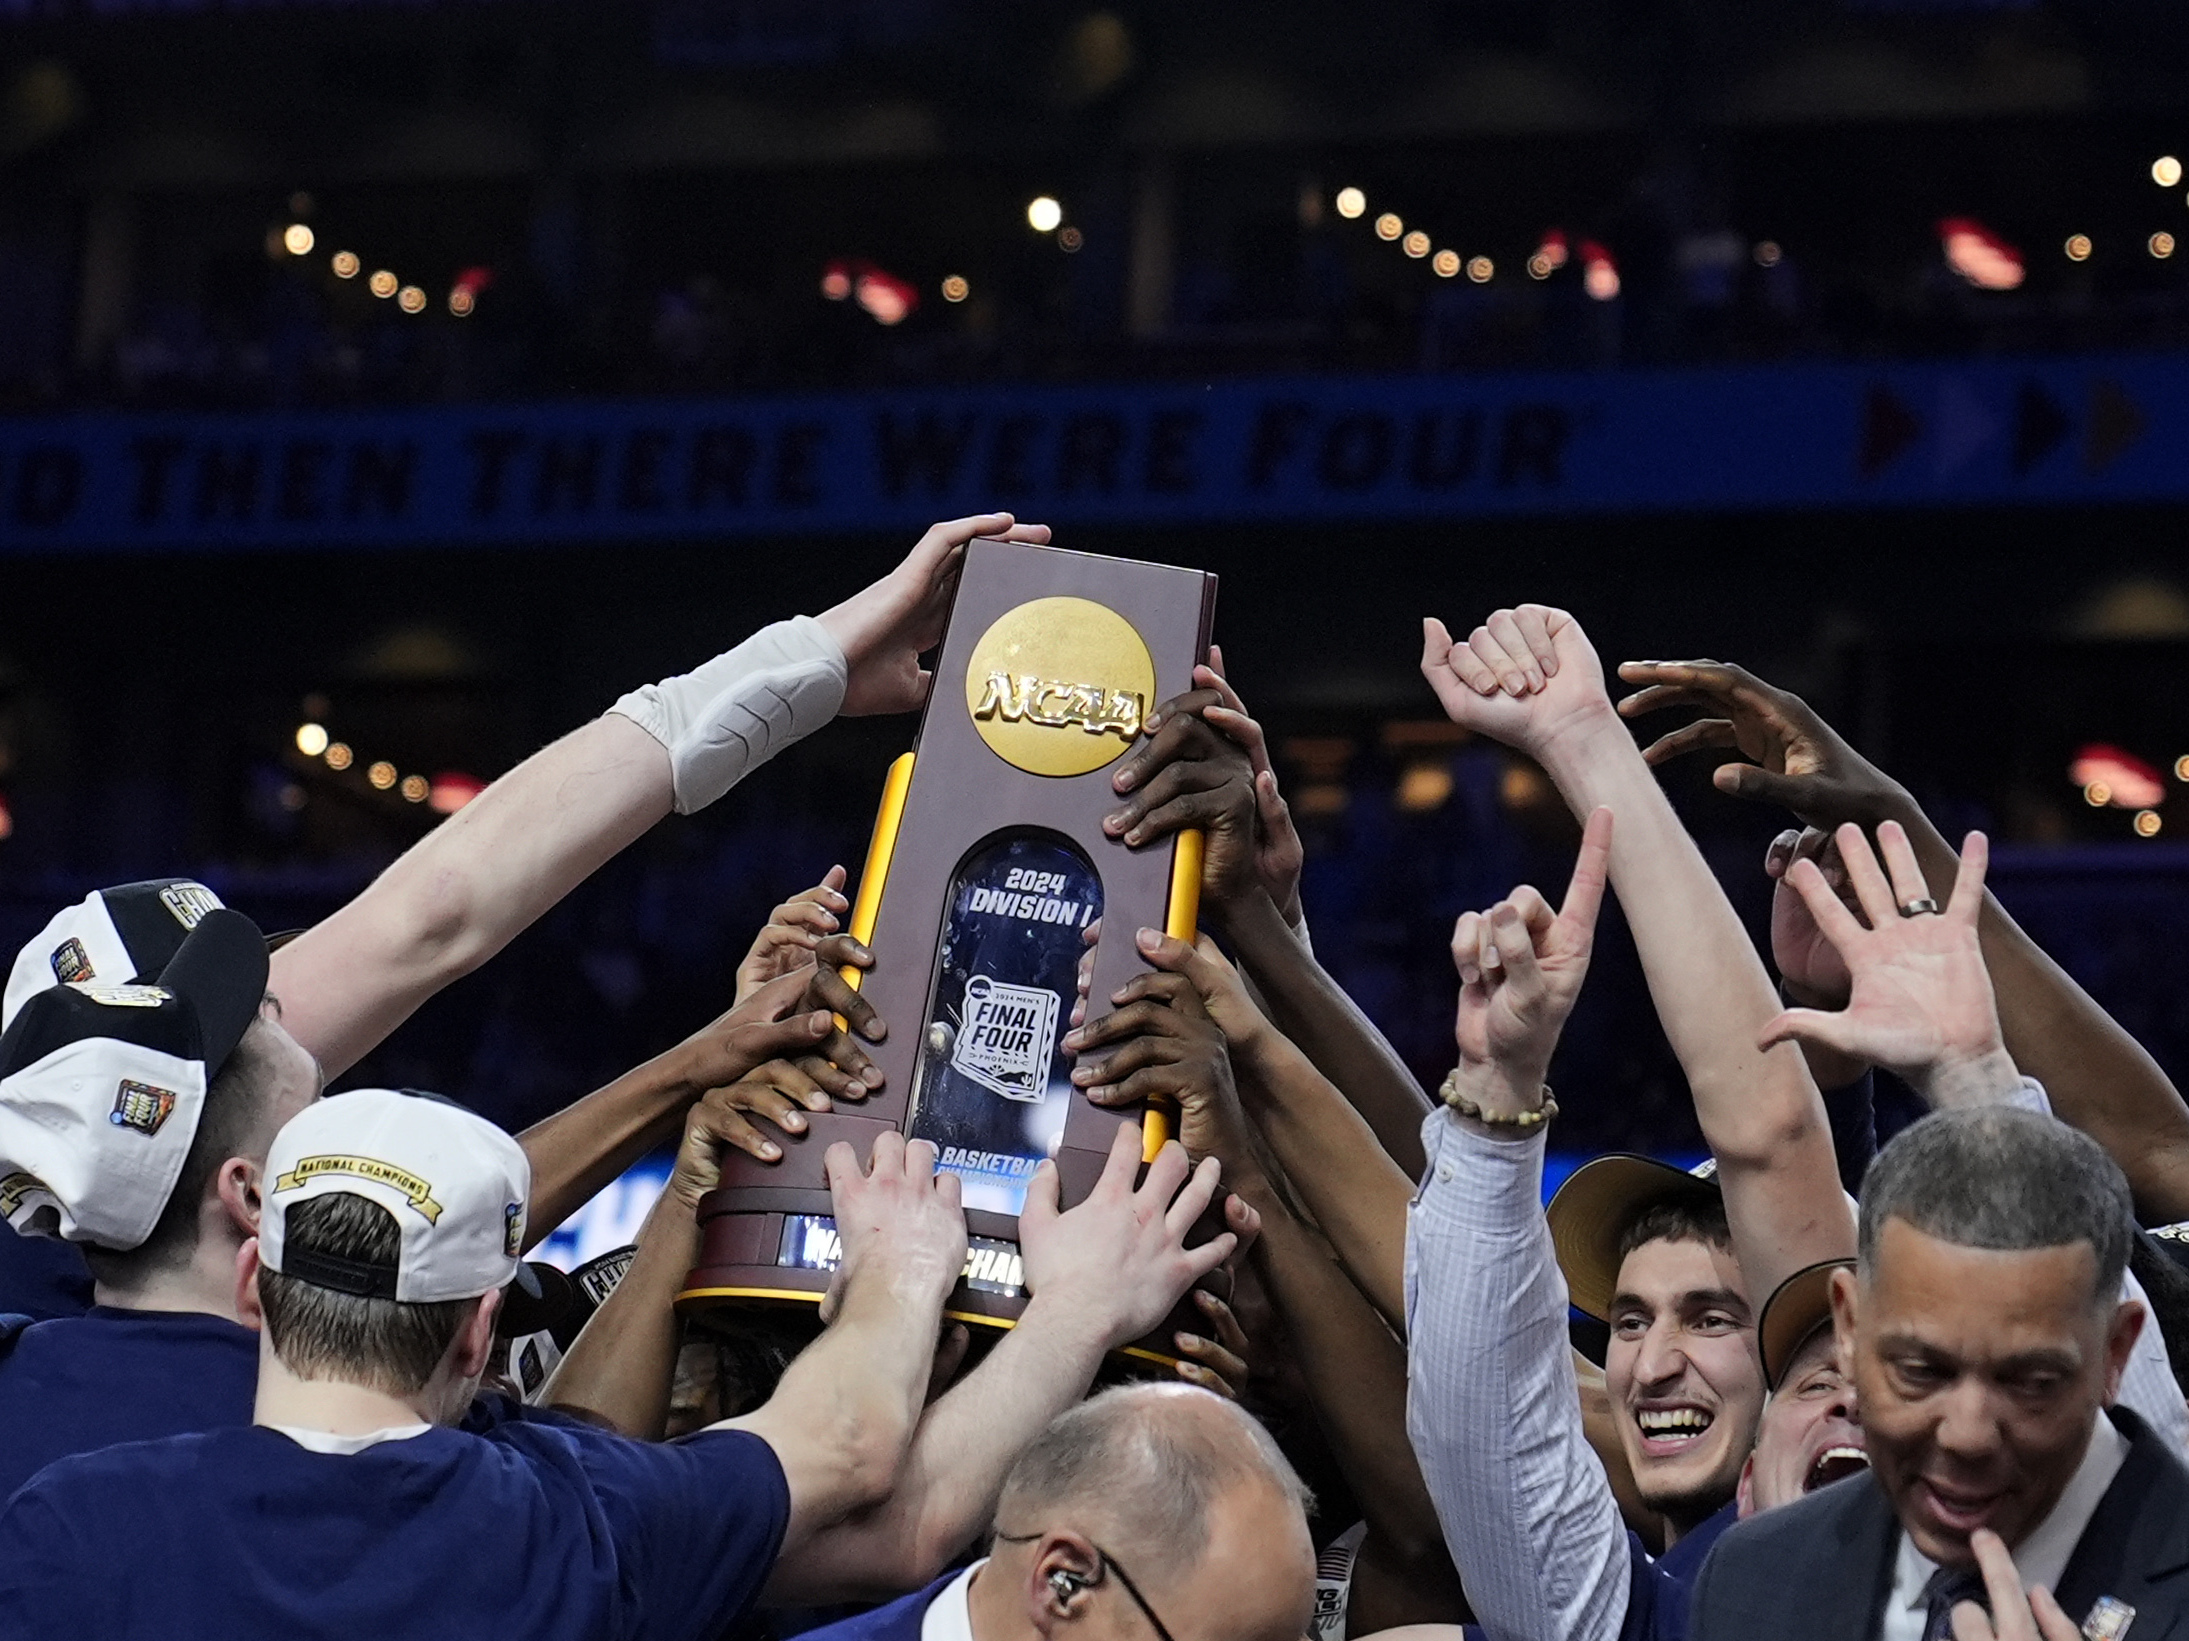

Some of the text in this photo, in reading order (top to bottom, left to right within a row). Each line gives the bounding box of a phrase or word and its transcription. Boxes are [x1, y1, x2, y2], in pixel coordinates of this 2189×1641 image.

[128, 433, 421, 527] THEN
[462, 422, 832, 520] THERE
[867, 409, 1197, 504] WERE
[1240, 399, 1580, 495] FOUR
[974, 670, 1145, 743] NCAA
[1005, 867, 1066, 896] 2024
[969, 888, 1094, 928] DIVISION I
[975, 1001, 1037, 1031] FINAL
[971, 1025, 1034, 1053] FOUR
[978, 1054, 1018, 1065] PHOENIX
[133, 1093, 152, 1127] FOUR
[300, 1159, 424, 1195] NATIONAL CHAMPIONS
[940, 1146, 1042, 1177] BASKETBA
